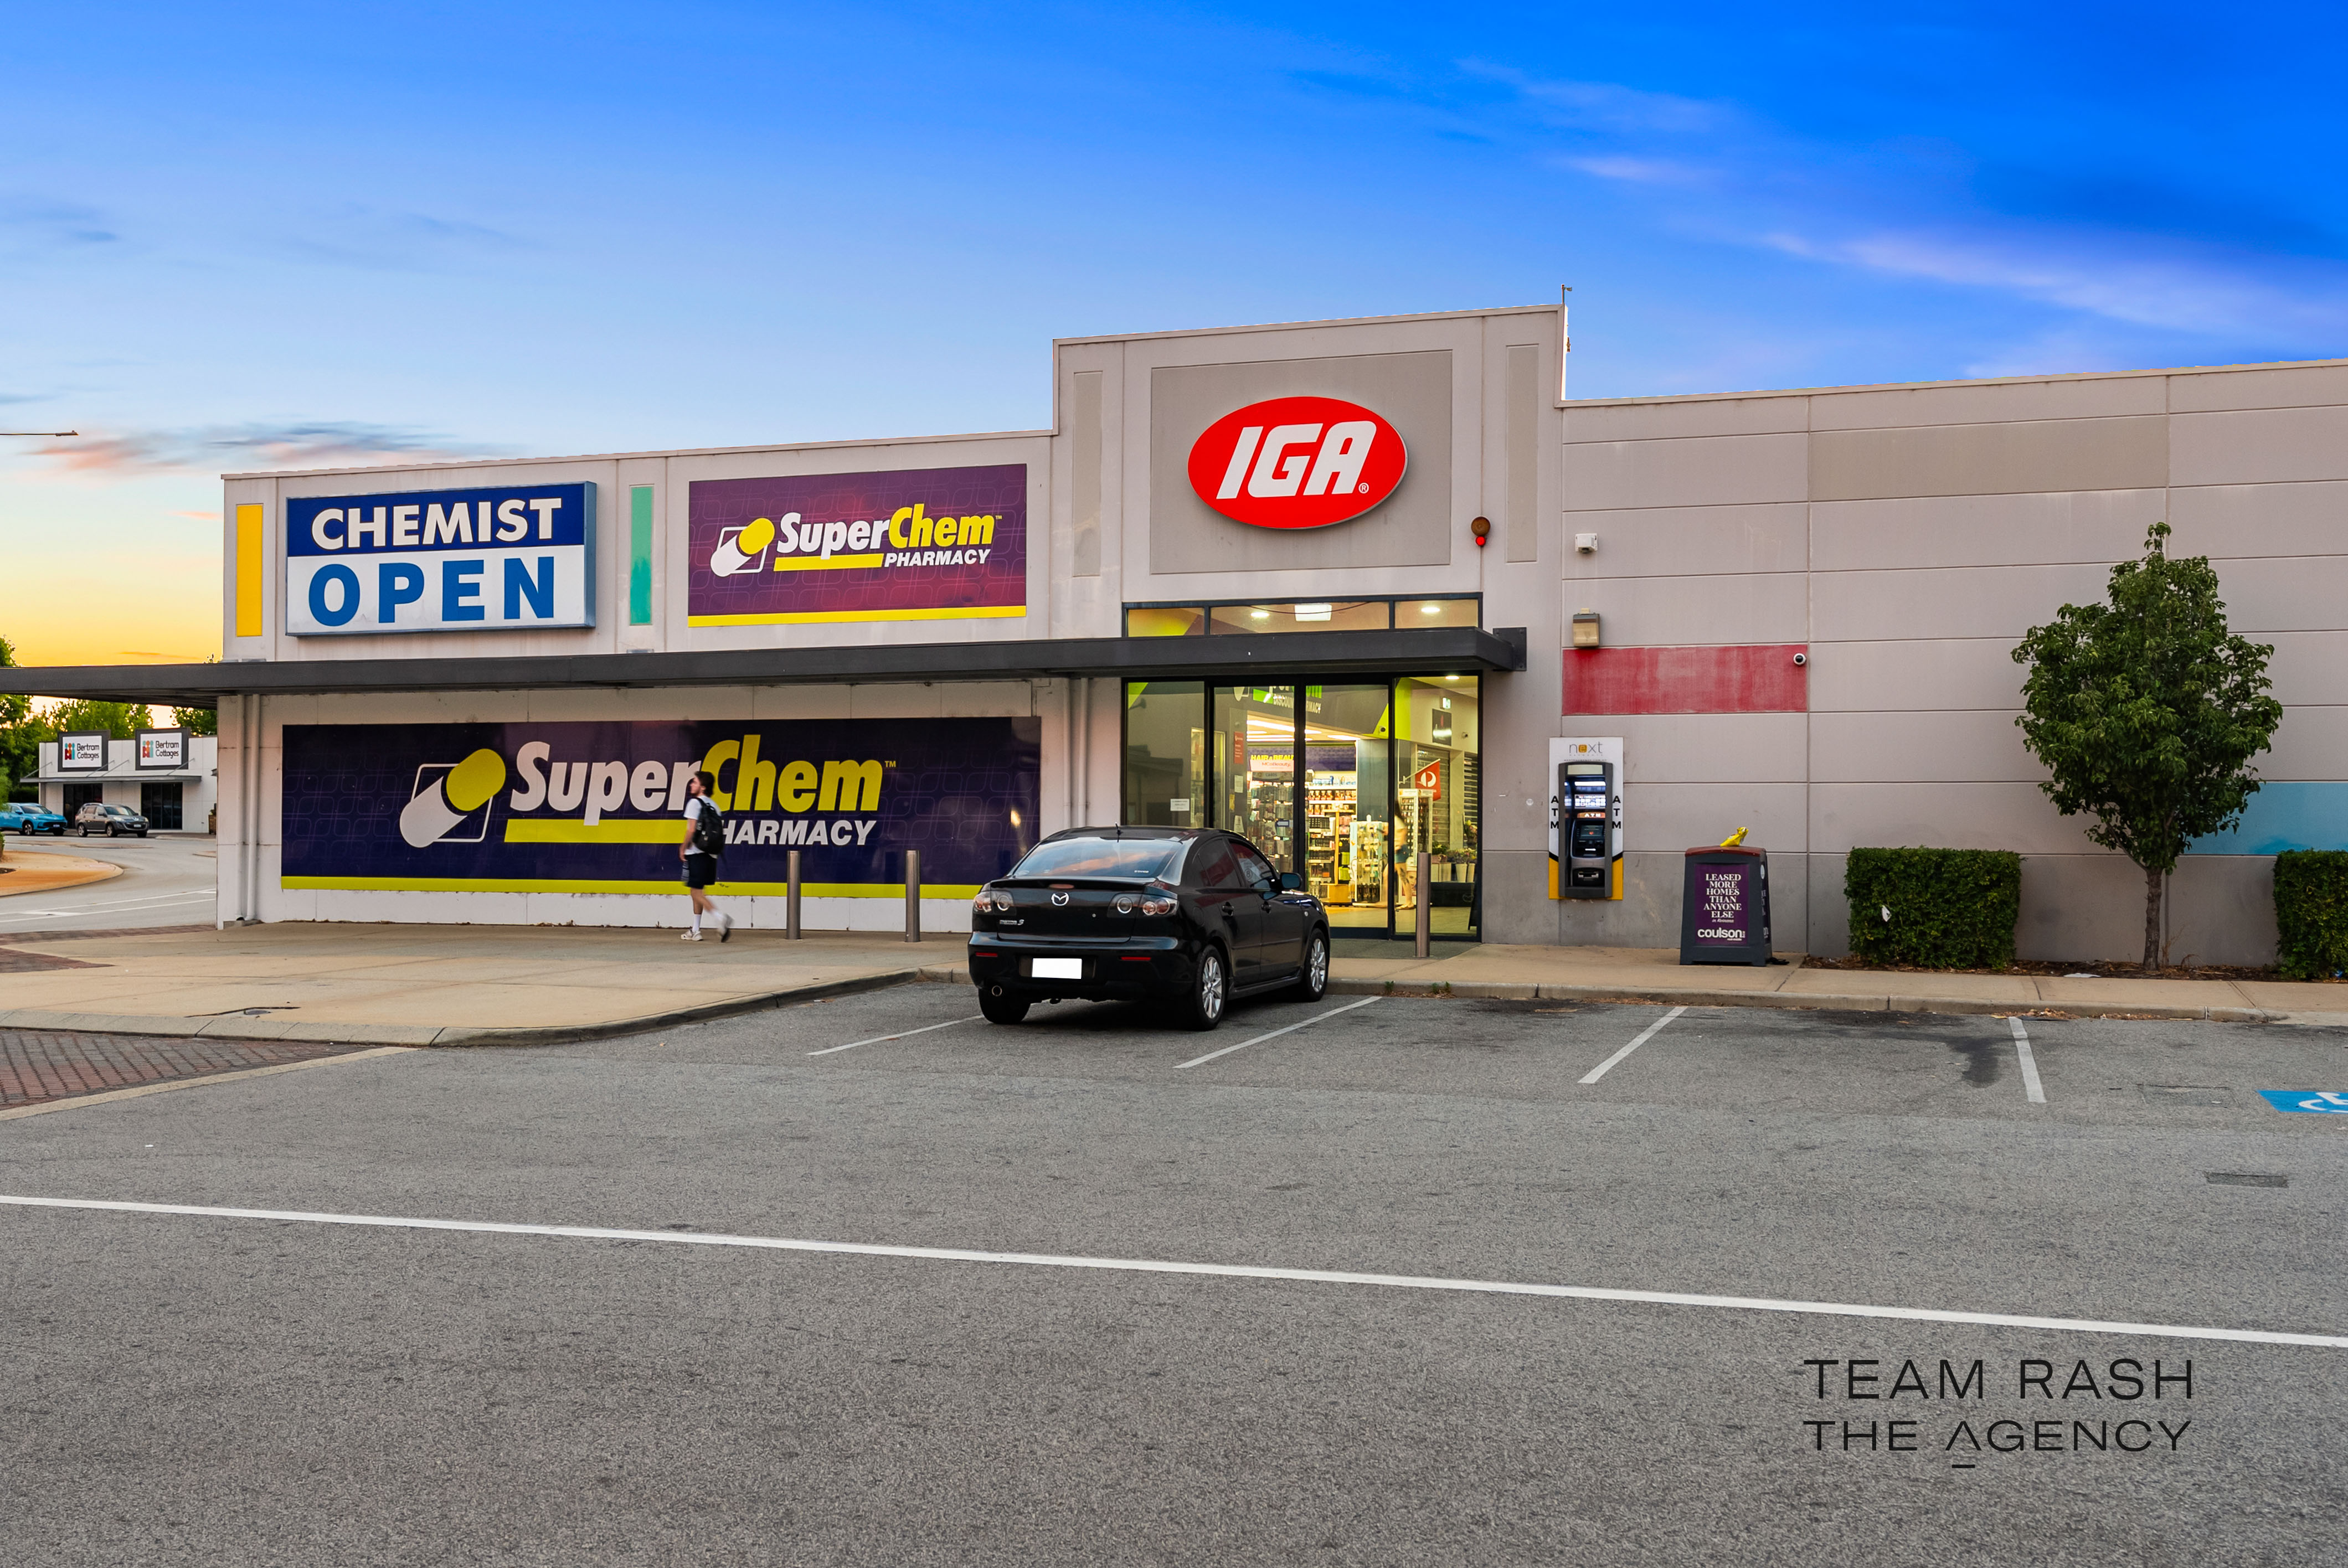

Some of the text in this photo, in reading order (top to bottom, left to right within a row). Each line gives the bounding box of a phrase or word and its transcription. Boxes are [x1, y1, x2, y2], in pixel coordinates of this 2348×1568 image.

[1216, 420, 1377, 499] IGA
[311, 497, 563, 550] CHEMIST
[776, 503, 995, 560] SuperChem
[884, 549, 991, 568] PHARMACY
[308, 556, 554, 627] OPEN
[1273, 693, 1295, 709] DISCOUN
[77, 752, 100, 761] Cottages
[156, 749, 179, 759] Cottages
[1569, 741, 1603, 754] next
[509, 734, 883, 826] SuperChem
[1551, 795, 1559, 829] ATM
[1612, 795, 1621, 829] ATM
[721, 819, 876, 846] HARMACY
[1697, 927, 1742, 938] coulson
